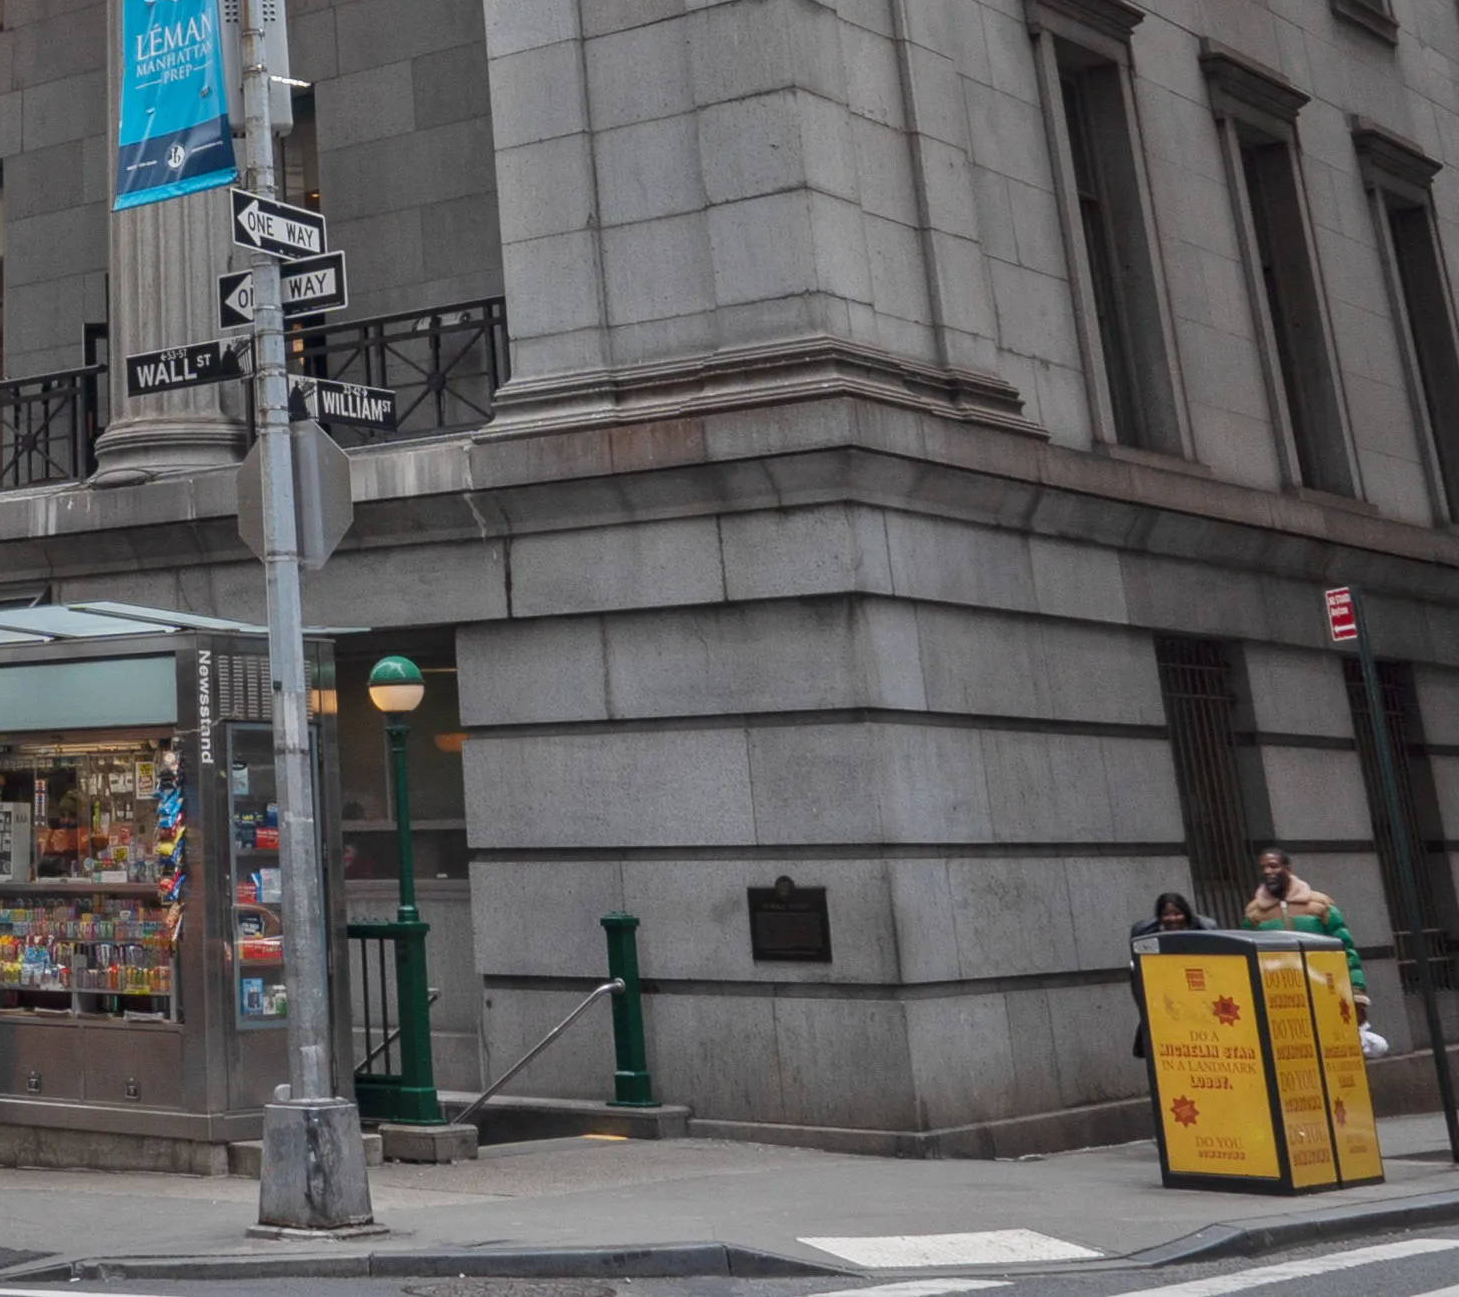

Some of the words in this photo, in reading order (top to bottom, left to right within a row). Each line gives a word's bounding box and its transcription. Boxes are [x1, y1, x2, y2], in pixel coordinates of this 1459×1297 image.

[163, 64, 193, 85] PREP
[248, 211, 274, 236] ONE
[286, 222, 314, 248] WAY
[289, 273, 327, 299] WAY
[137, 358, 197, 388] WALL
[197, 354, 211, 367] ST
[322, 390, 384, 422] WILLIAM
[383, 400, 392, 413] ST
[198, 649, 215, 765] Newsstand
[1190, 1030, 1207, 1042] DO
[1211, 1031, 1220, 1042] A
[1160, 1044, 1219, 1059] MICHELIN
[1223, 1046, 1257, 1061] STAR
[1161, 1061, 1175, 1072] IN
[1176, 1061, 1187, 1072] A
[1187, 1061, 1258, 1074] LANDMARK
[1195, 1136, 1214, 1148] DO
[1215, 1137, 1243, 1150] YOU
